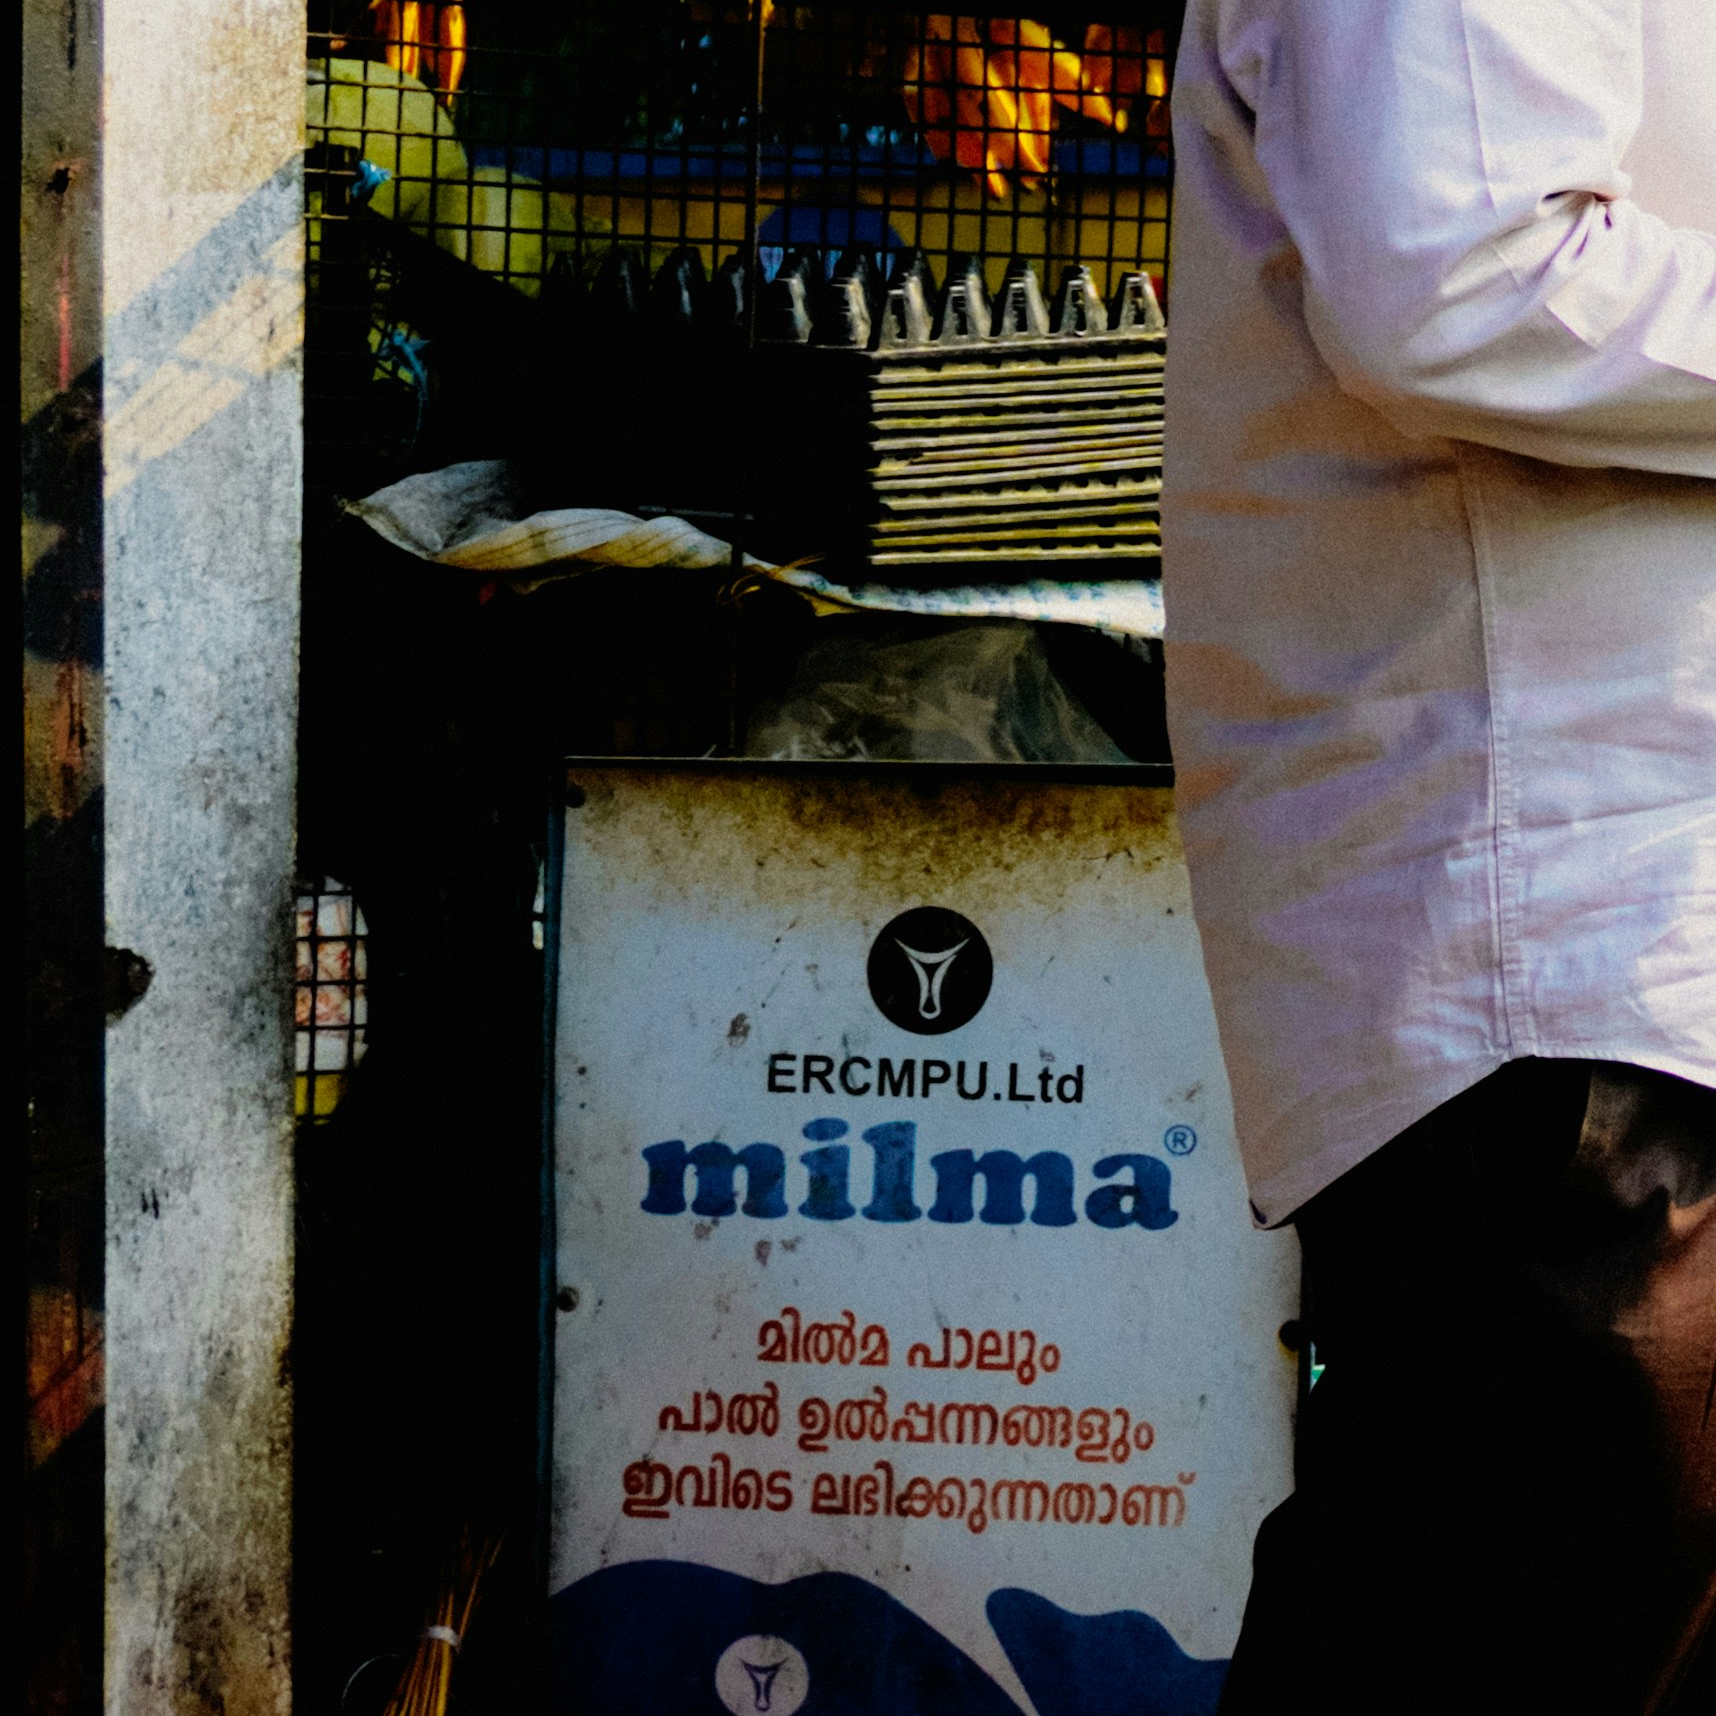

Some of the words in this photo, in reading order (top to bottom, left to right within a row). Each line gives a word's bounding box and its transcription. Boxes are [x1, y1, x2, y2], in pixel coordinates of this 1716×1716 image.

[767, 1053, 1085, 1105] ERCMPU.Ltd
[639, 1117, 1179, 1231] milma
[757, 1307, 890, 1367] മിൽമ
[906, 1325, 1061, 1385] പാലും
[659, 1382, 778, 1438] പാൽ
[797, 1385, 1154, 1463] ഉൽപ്പന്നങ്ങളും
[623, 1451, 792, 1518] ഇവിടെ
[812, 1459, 1196, 1535] ലഭിക്കുന്നതാണ്
